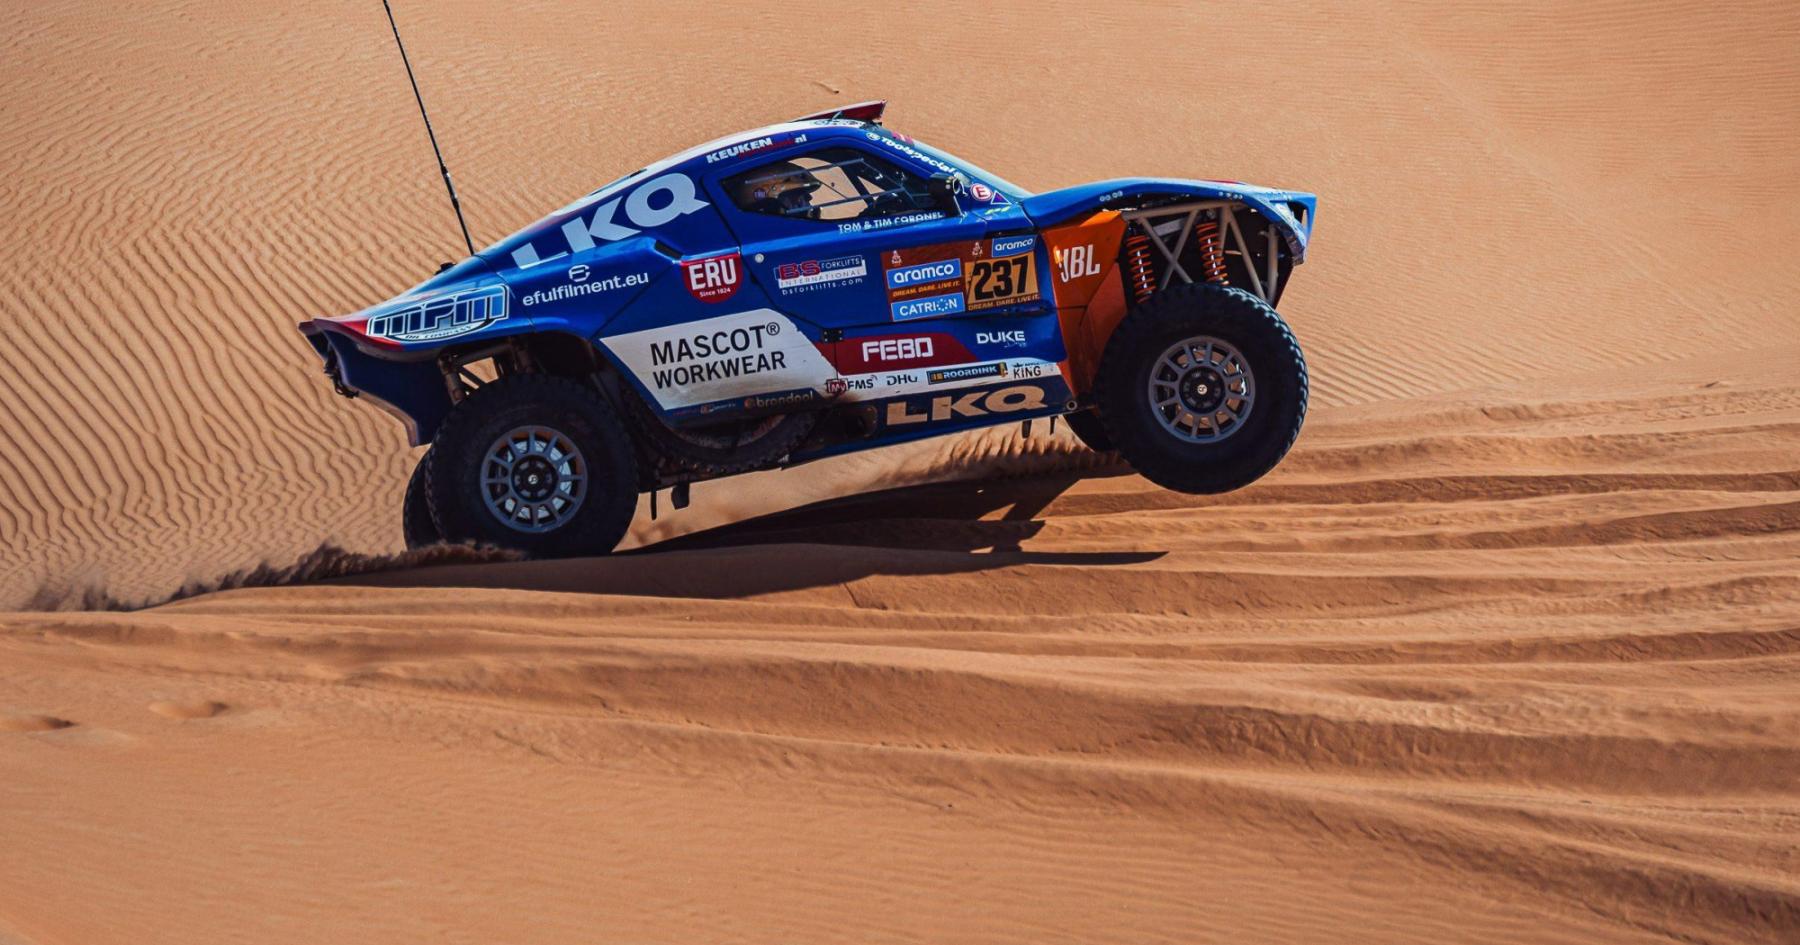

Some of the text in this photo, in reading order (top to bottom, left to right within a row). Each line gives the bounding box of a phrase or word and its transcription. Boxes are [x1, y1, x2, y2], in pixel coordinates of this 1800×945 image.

[511, 172, 711, 270] LKQ
[837, 222, 862, 235] TOM
[873, 217, 892, 229] TIM
[994, 237, 1034, 252] aramco
[688, 257, 737, 291] ERU
[778, 257, 861, 280] BS FORKLIFTS
[893, 263, 955, 284] aramco
[1059, 244, 1101, 284] JBL
[782, 278, 863, 296] bsforklifts.com
[938, 281, 952, 290] LIVE
[973, 255, 1029, 300] 237
[522, 272, 650, 307] efulfilment.eu
[699, 289, 716, 298] Since
[1017, 296, 1031, 304] LIVE
[976, 330, 1026, 345] DUKE
[861, 336, 934, 362] FEBO
[652, 350, 787, 390] WORKWEAR
[1013, 365, 1042, 379] KING
[886, 385, 1048, 426] LKQ
